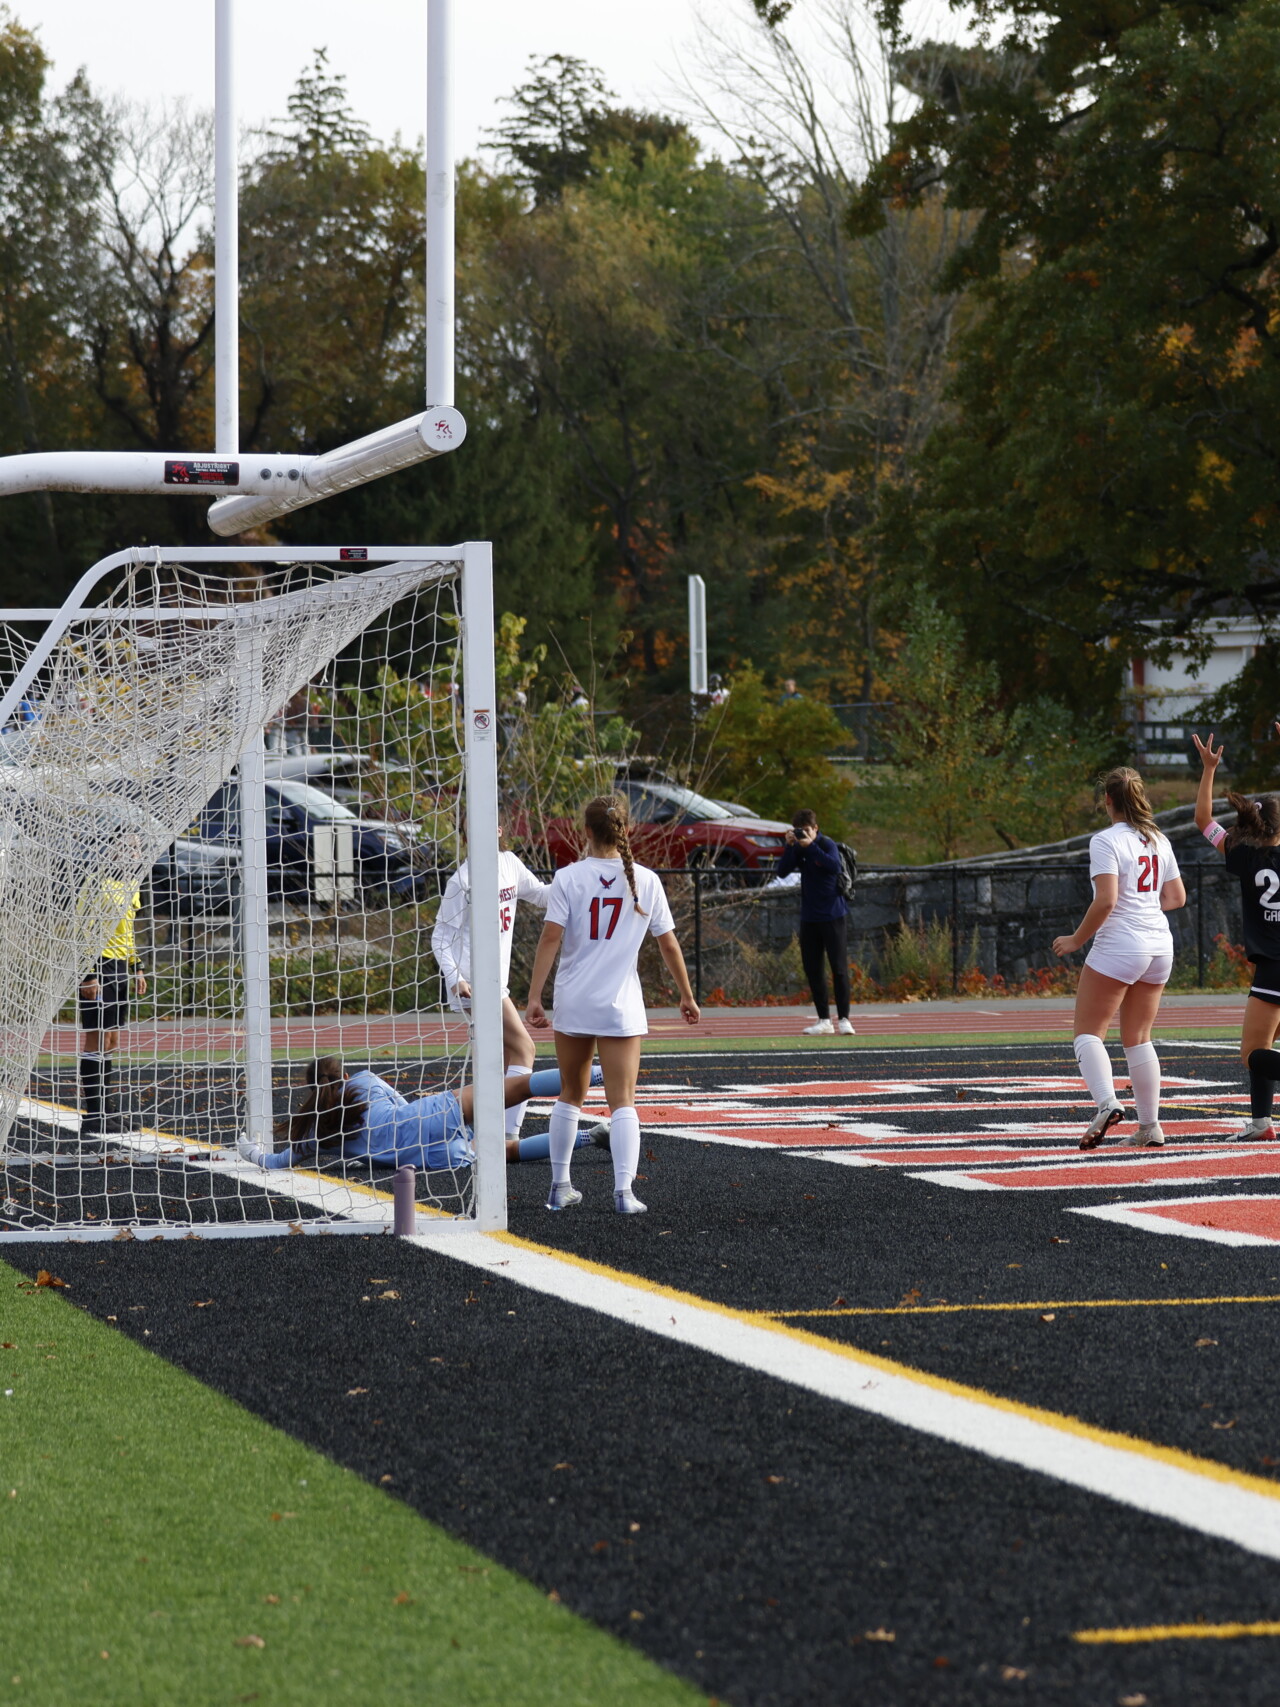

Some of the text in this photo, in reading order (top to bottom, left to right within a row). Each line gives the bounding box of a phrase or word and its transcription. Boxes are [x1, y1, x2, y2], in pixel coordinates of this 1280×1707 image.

[1137, 855, 1159, 893] 21
[500, 907, 511, 933] 16
[589, 897, 623, 940] 17
